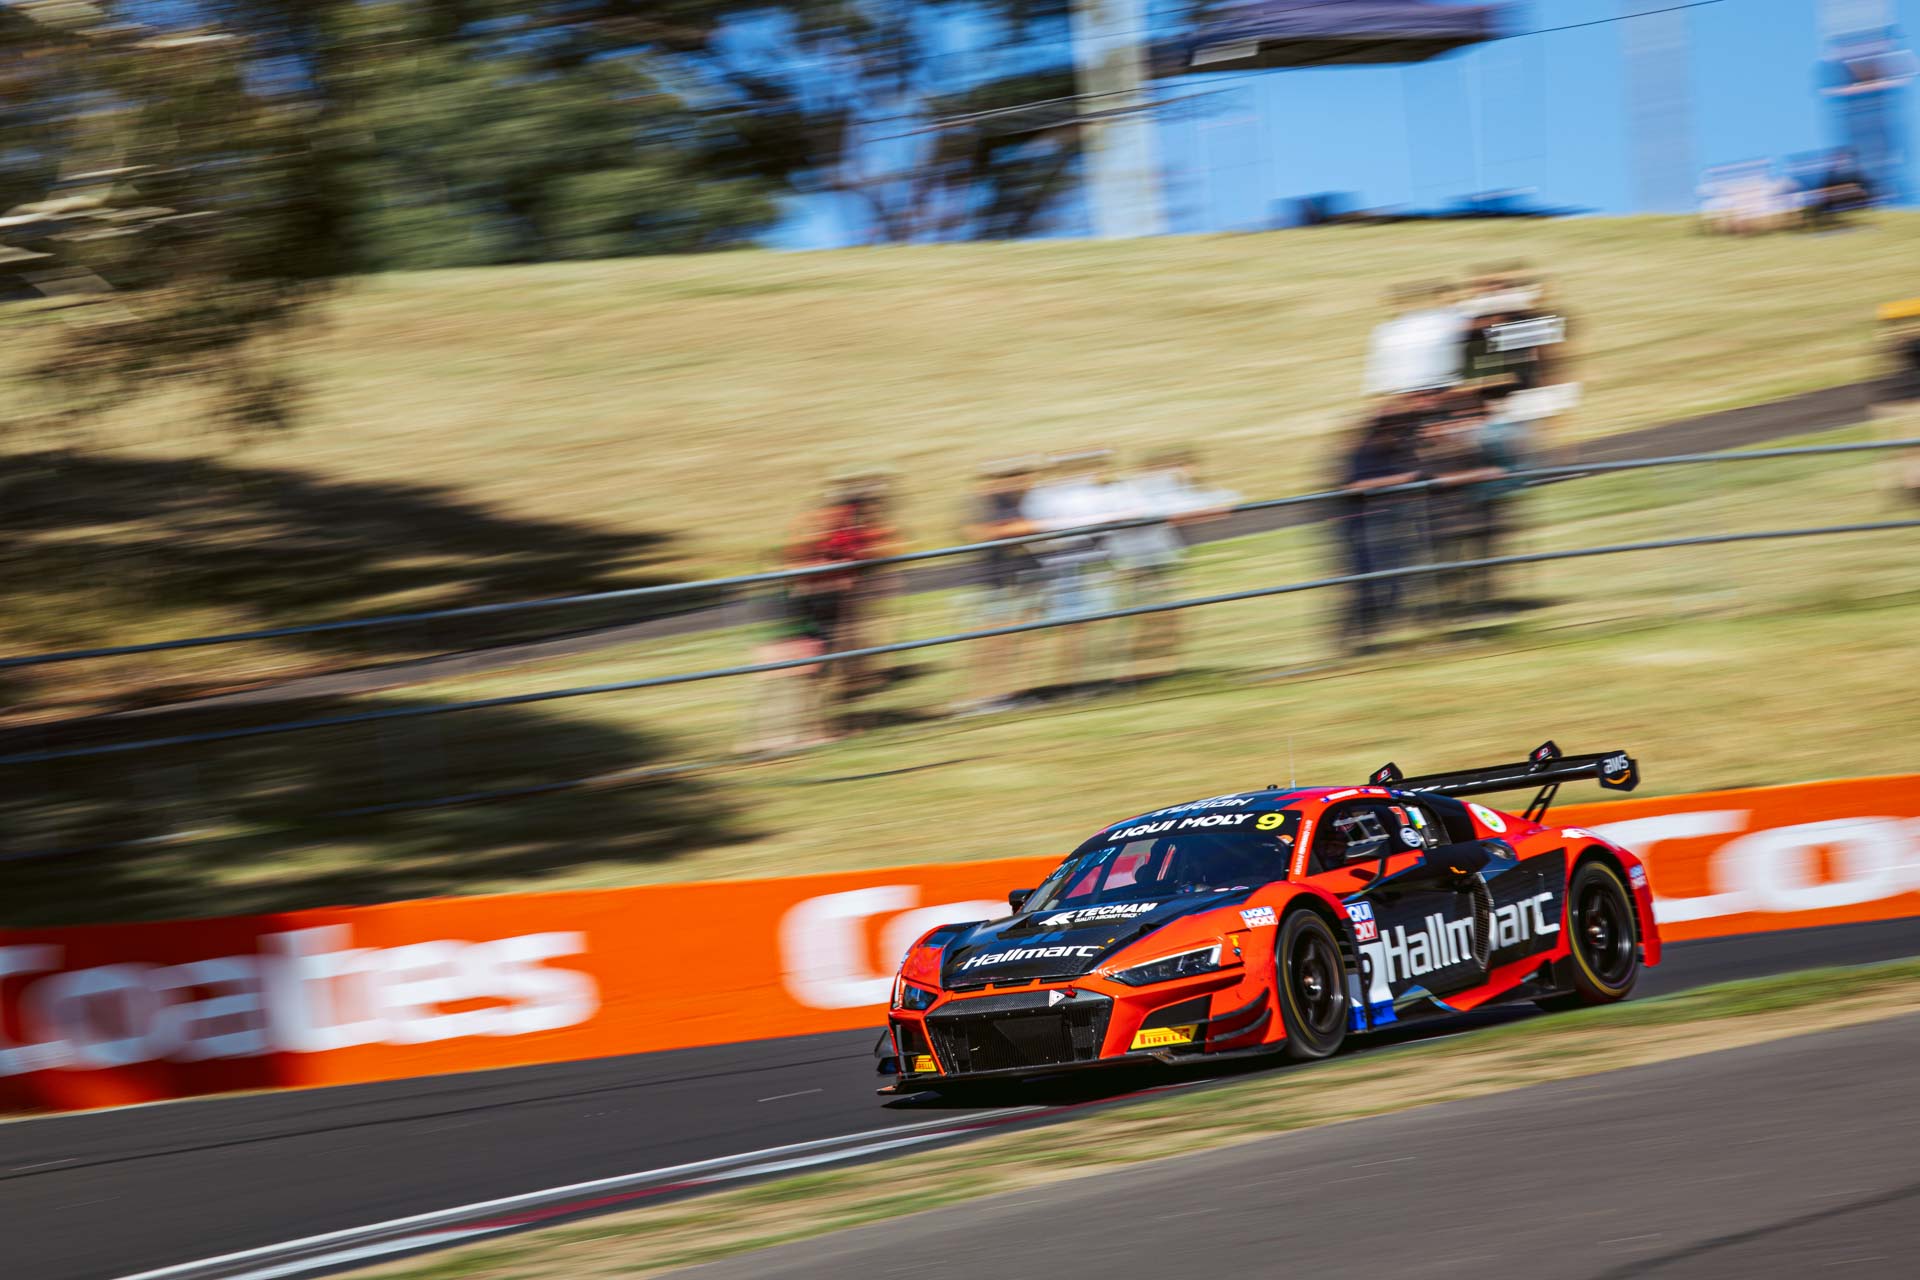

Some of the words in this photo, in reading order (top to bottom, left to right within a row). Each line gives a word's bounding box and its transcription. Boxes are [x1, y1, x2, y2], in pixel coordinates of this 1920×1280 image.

[1602, 754, 1629, 774] aws
[1107, 819, 1177, 842] LIQUI
[1177, 813, 1255, 830] MOLY
[1255, 813, 1285, 831] 9
[1076, 902, 1159, 918] TECNAM
[1380, 891, 1561, 983] Hallmarc
[962, 945, 1100, 970] Hallmarc
